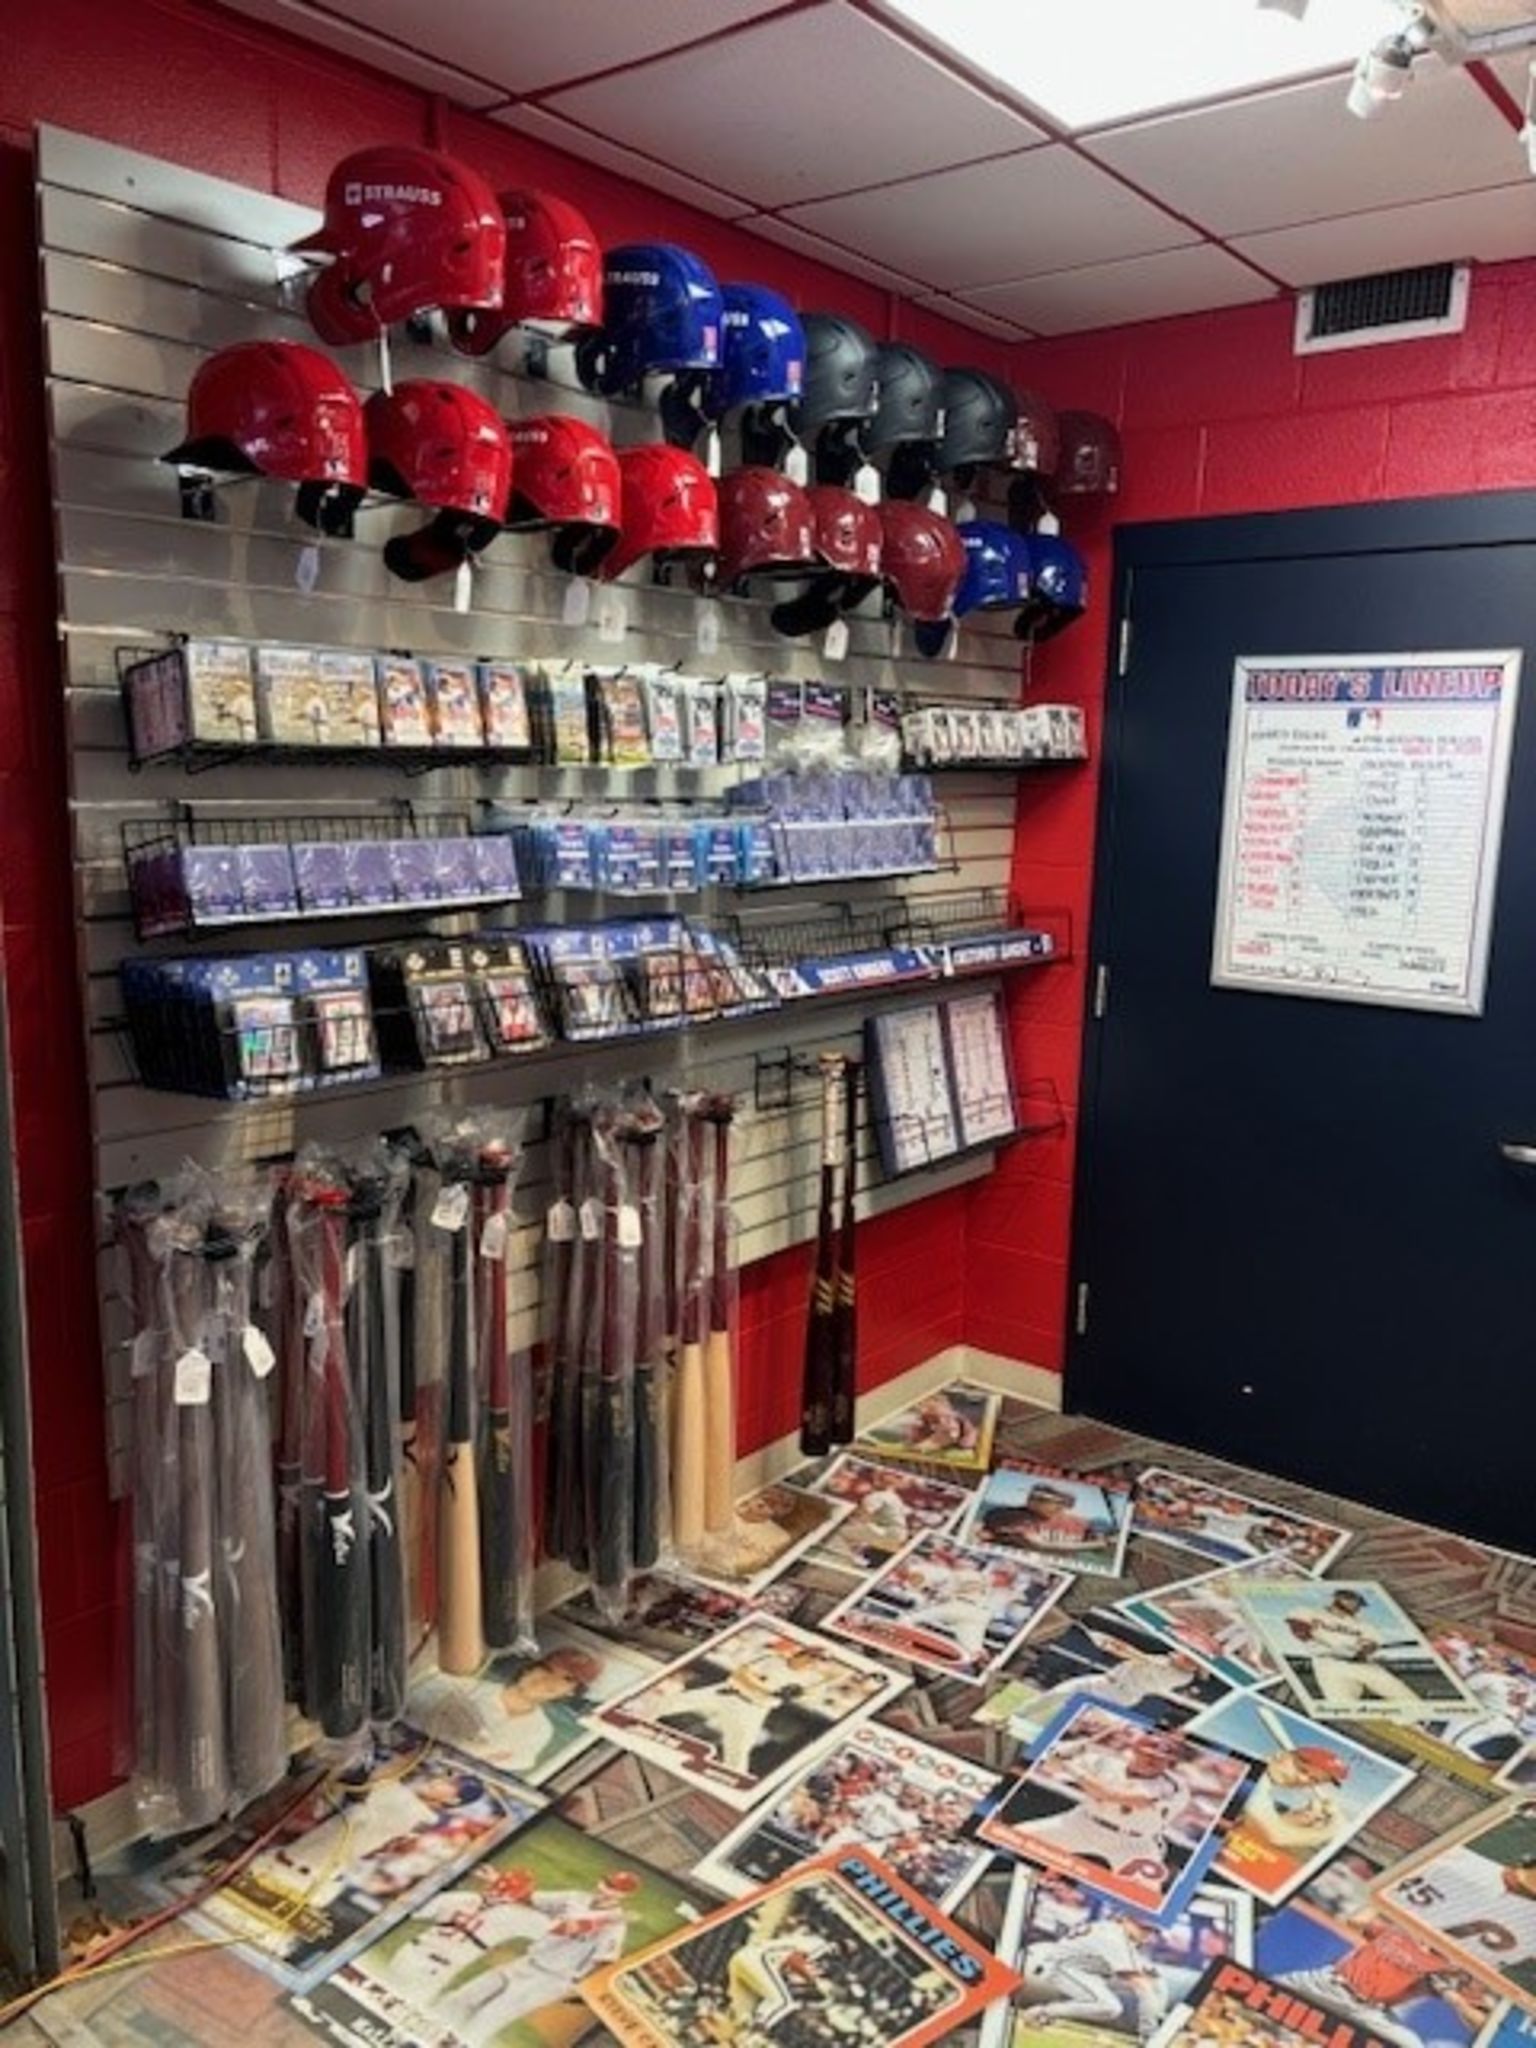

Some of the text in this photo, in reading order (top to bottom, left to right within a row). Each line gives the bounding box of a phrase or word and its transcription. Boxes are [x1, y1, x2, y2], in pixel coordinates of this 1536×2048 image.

[364, 184, 442, 206] STRAUSS
[1248, 667, 1502, 699] TODAY'S LINEUP
[1398, 1877, 1444, 1906] 45
[837, 1858, 983, 1982] PHILLIES
